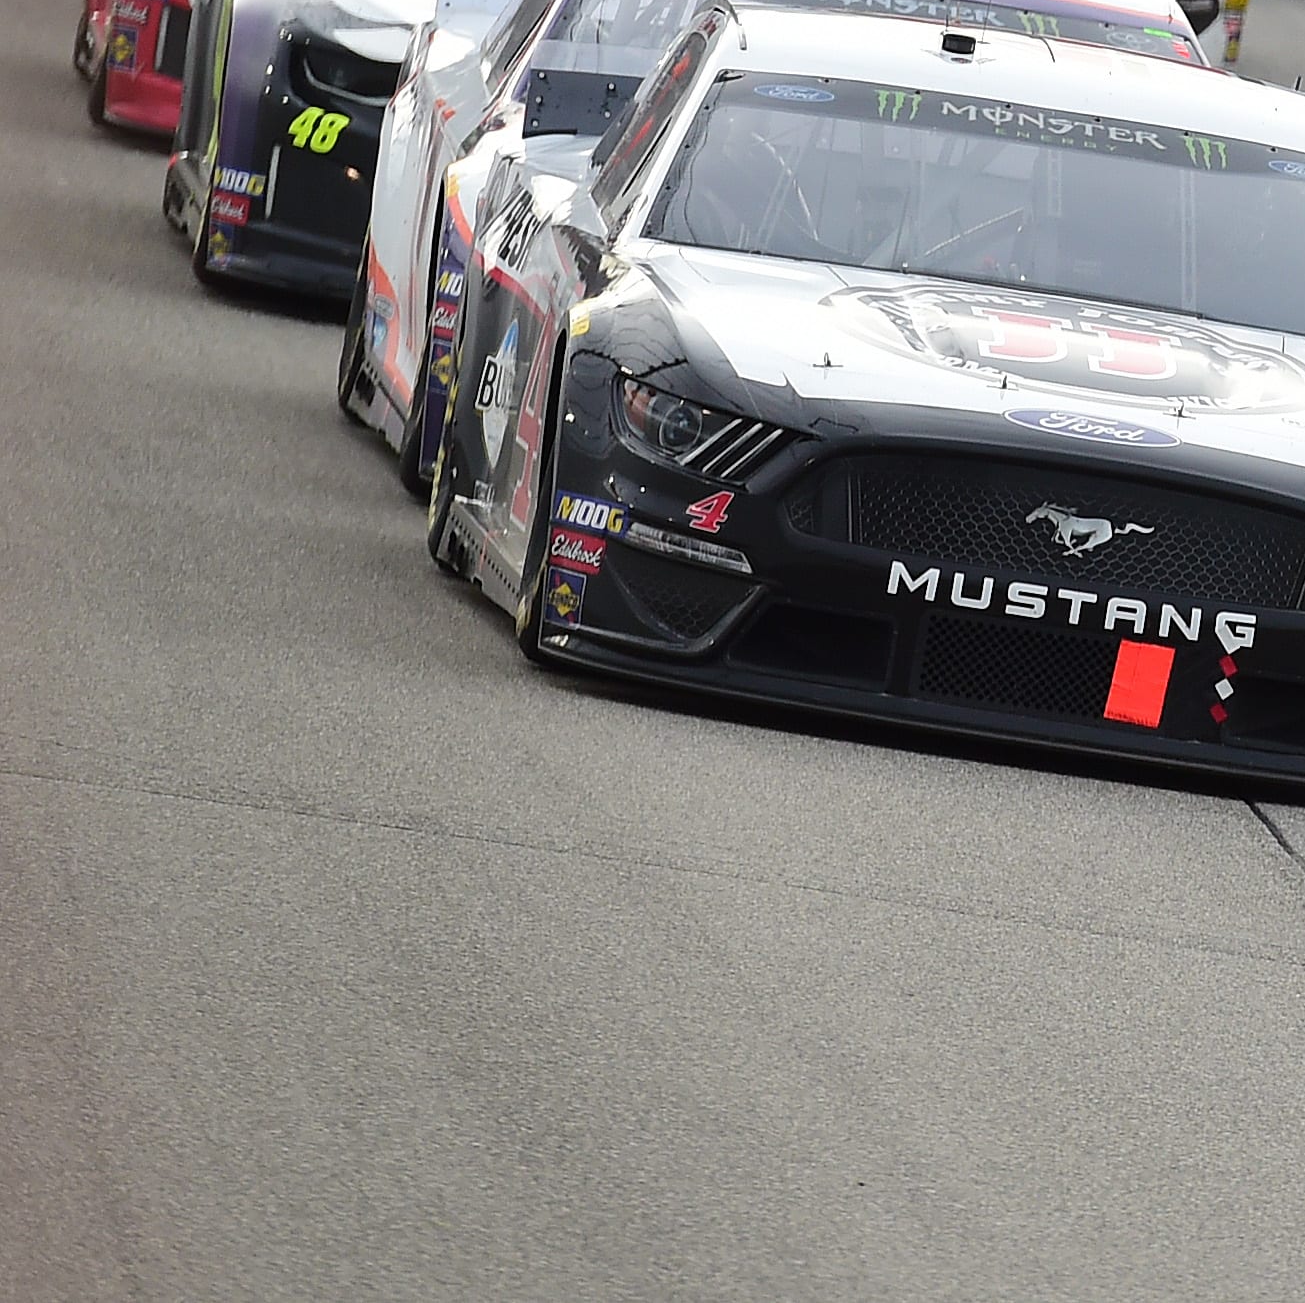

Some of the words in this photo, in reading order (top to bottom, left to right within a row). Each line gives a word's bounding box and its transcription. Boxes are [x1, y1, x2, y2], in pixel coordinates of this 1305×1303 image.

[288, 105, 350, 153] 48
[940, 100, 1168, 150] MONSTER
[1038, 410, 1147, 443] Ford
[555, 495, 625, 534] MOOG
[685, 490, 736, 534] 4
[886, 559, 1258, 653] MUSTANG
